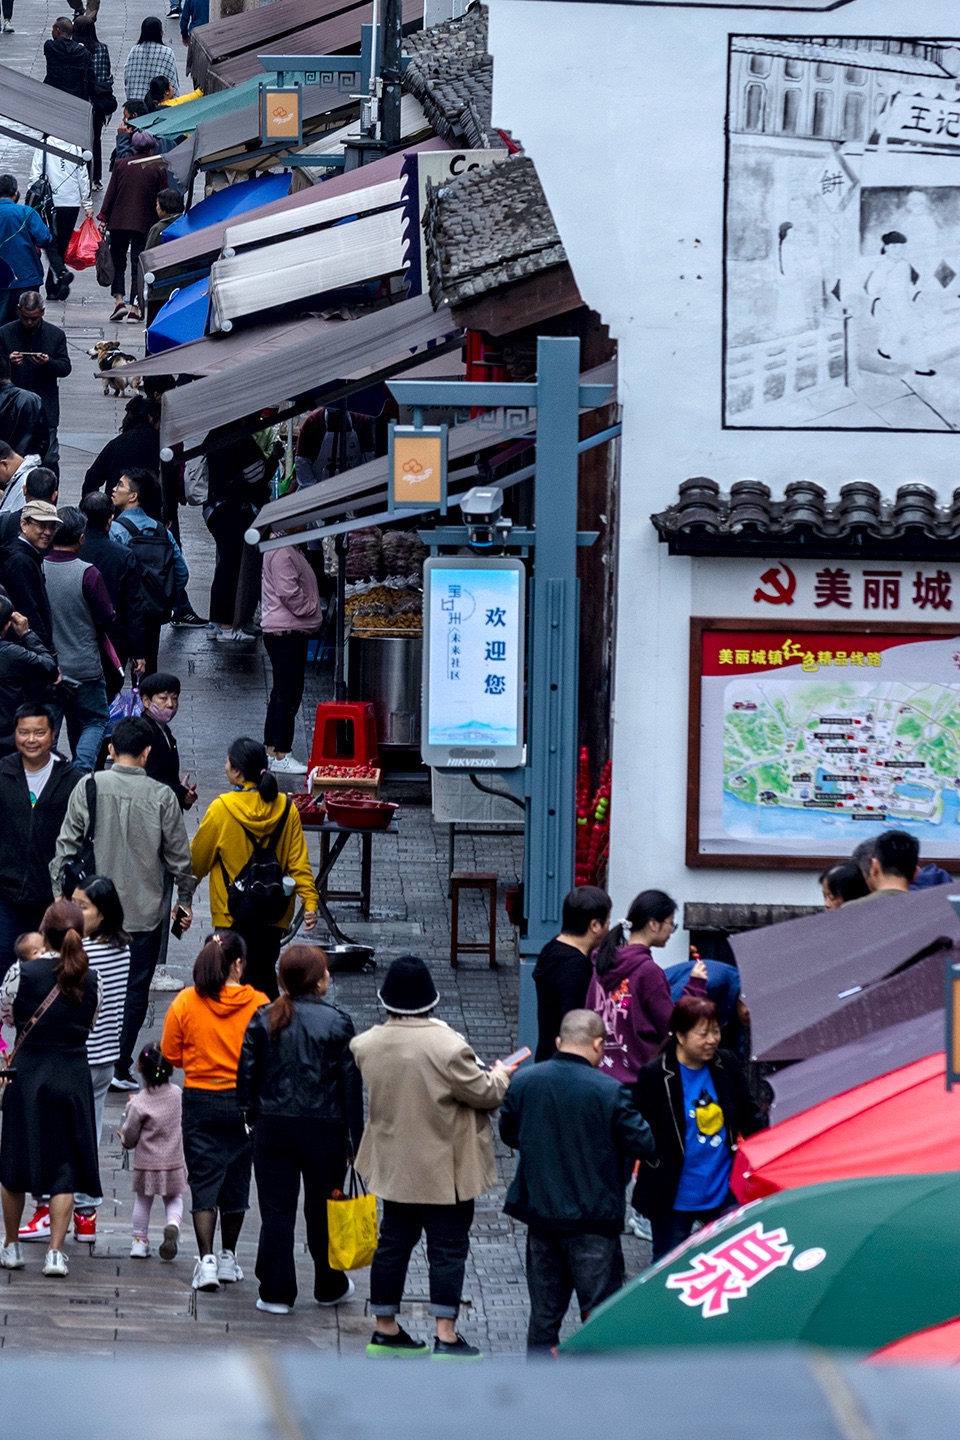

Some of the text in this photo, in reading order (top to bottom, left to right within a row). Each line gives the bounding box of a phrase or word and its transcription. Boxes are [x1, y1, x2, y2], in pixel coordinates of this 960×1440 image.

[901, 106, 960, 138] 王记
[814, 568, 953, 610] 美丽城
[450, 632, 462, 680] 未来社区
[484, 607, 506, 695] 欢迎您
[718, 639, 882, 672] 美丽城镇红色精品线路
[447, 758, 497, 767] HIKVISION
